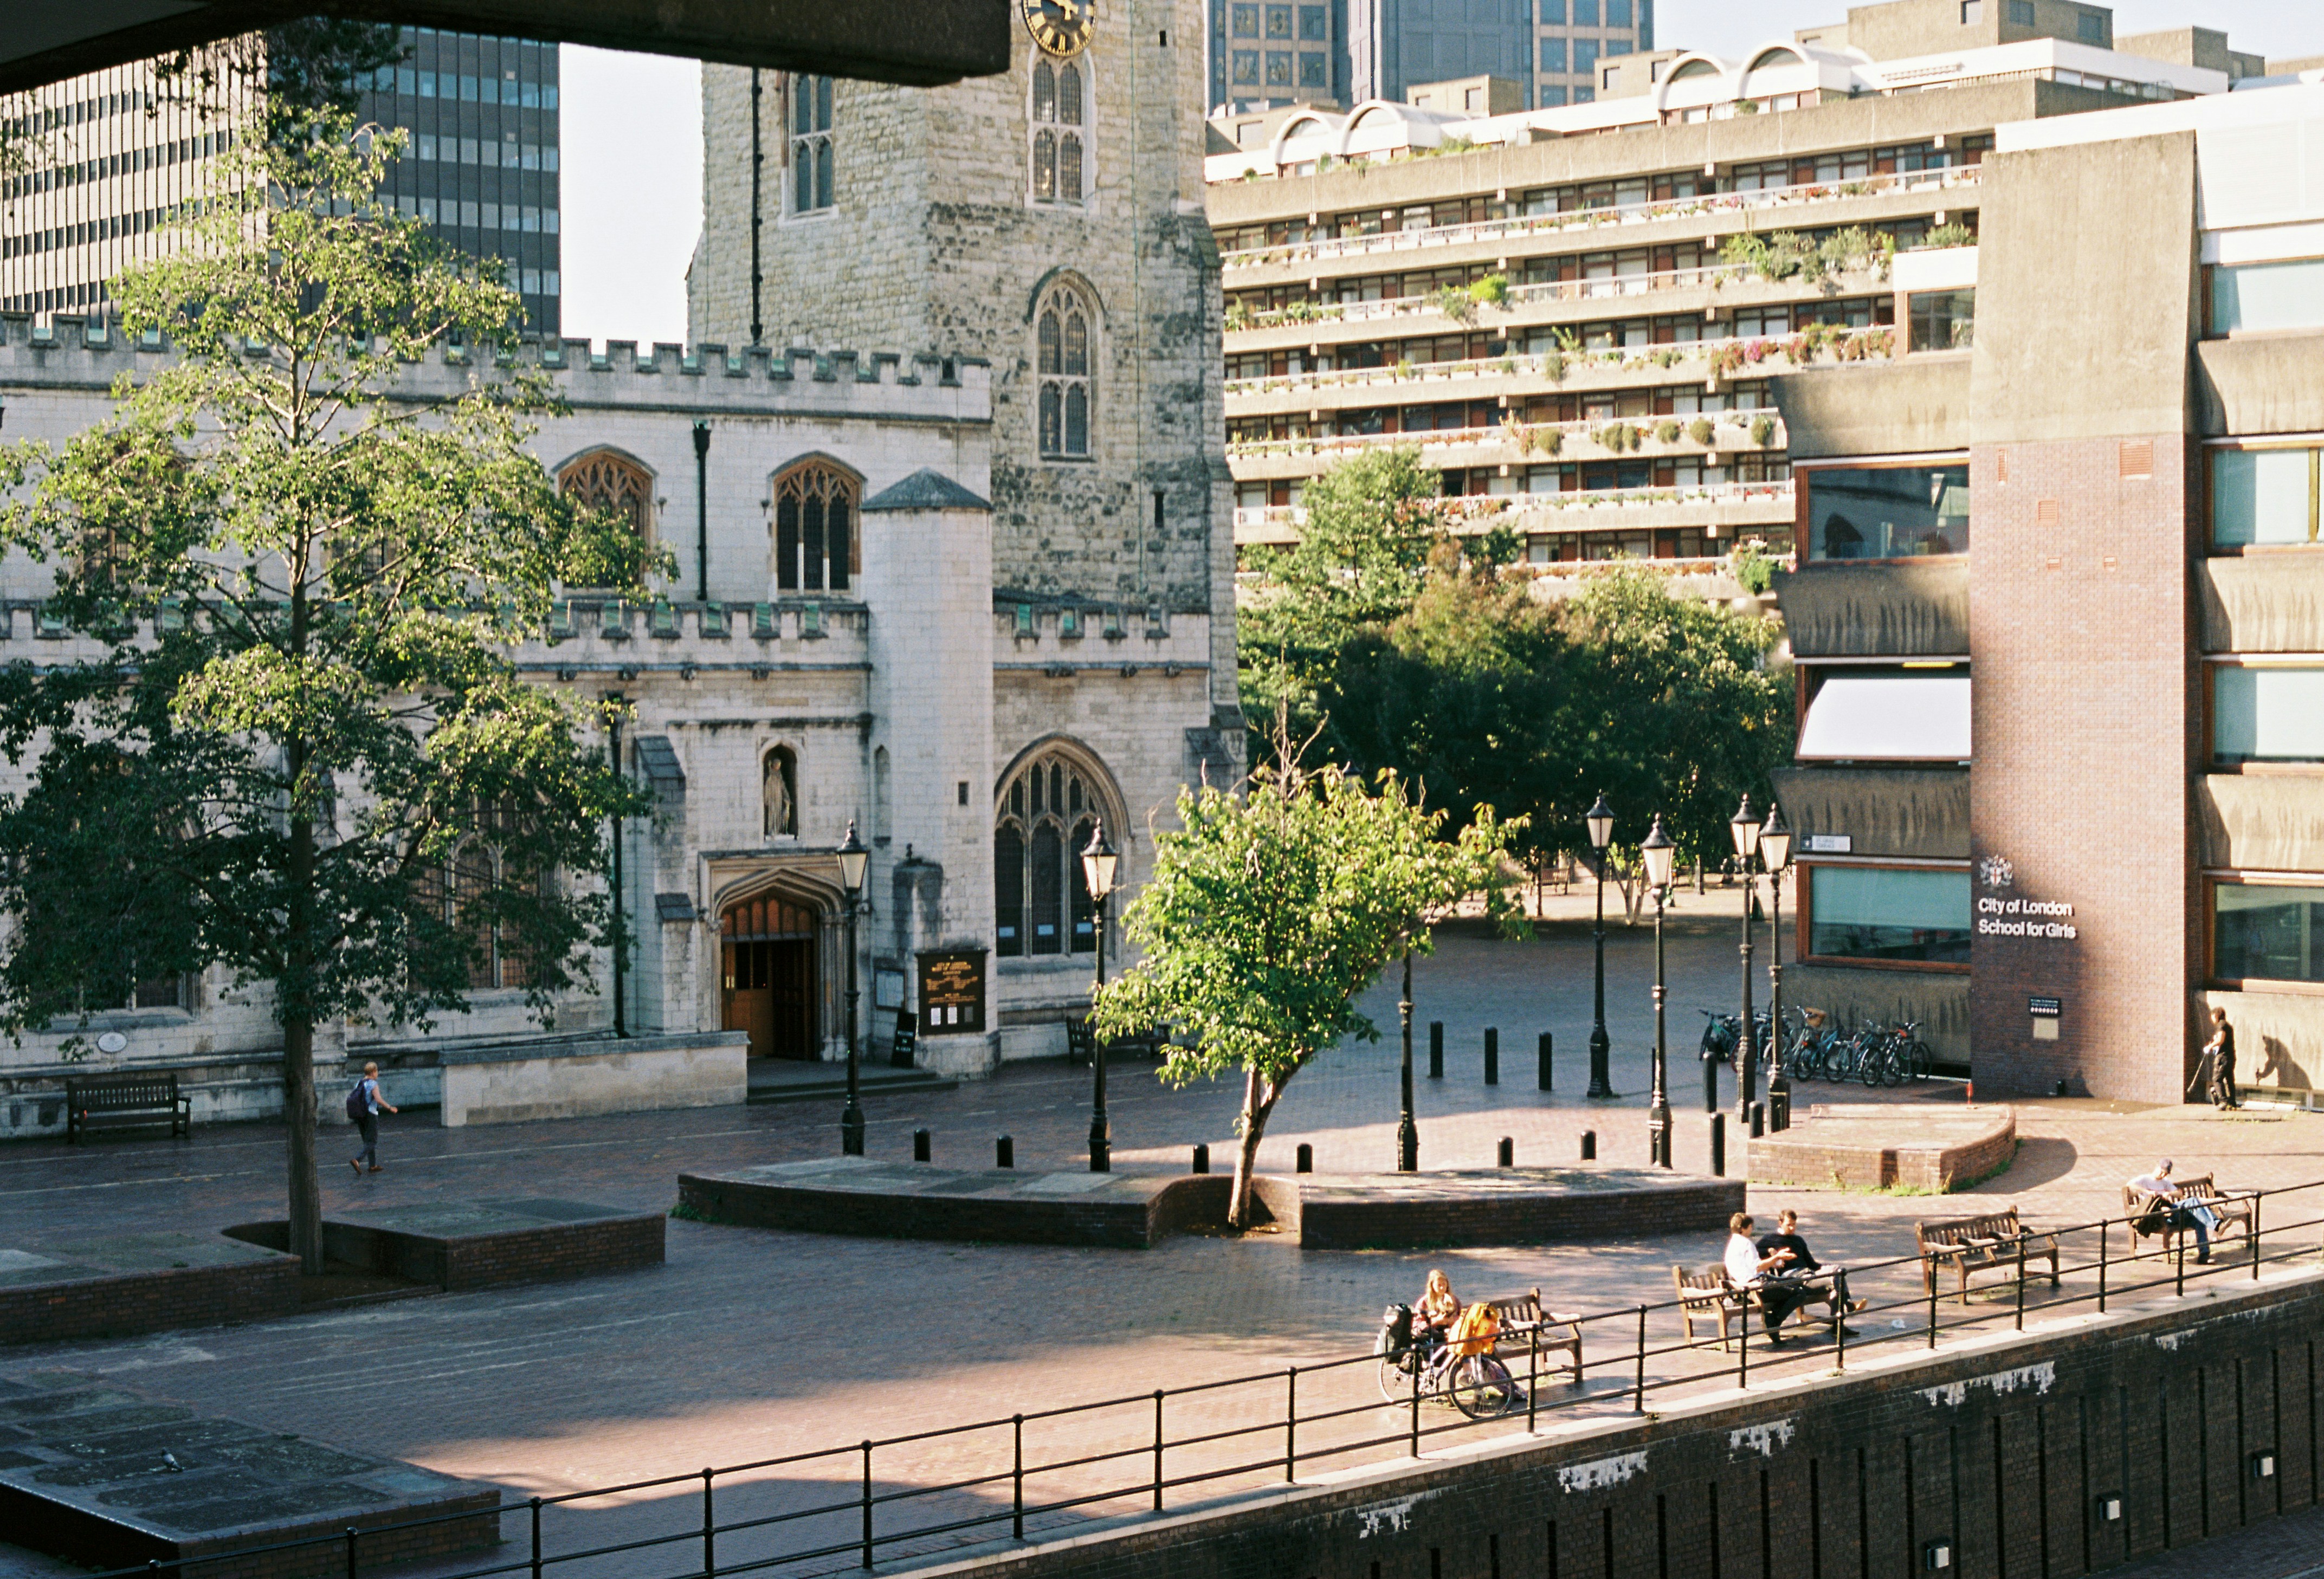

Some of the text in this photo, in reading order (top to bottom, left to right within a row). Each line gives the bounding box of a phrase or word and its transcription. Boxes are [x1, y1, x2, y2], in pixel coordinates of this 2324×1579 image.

[1979, 898, 2072, 916] City of London
[1979, 919, 2076, 939] School for Girls
